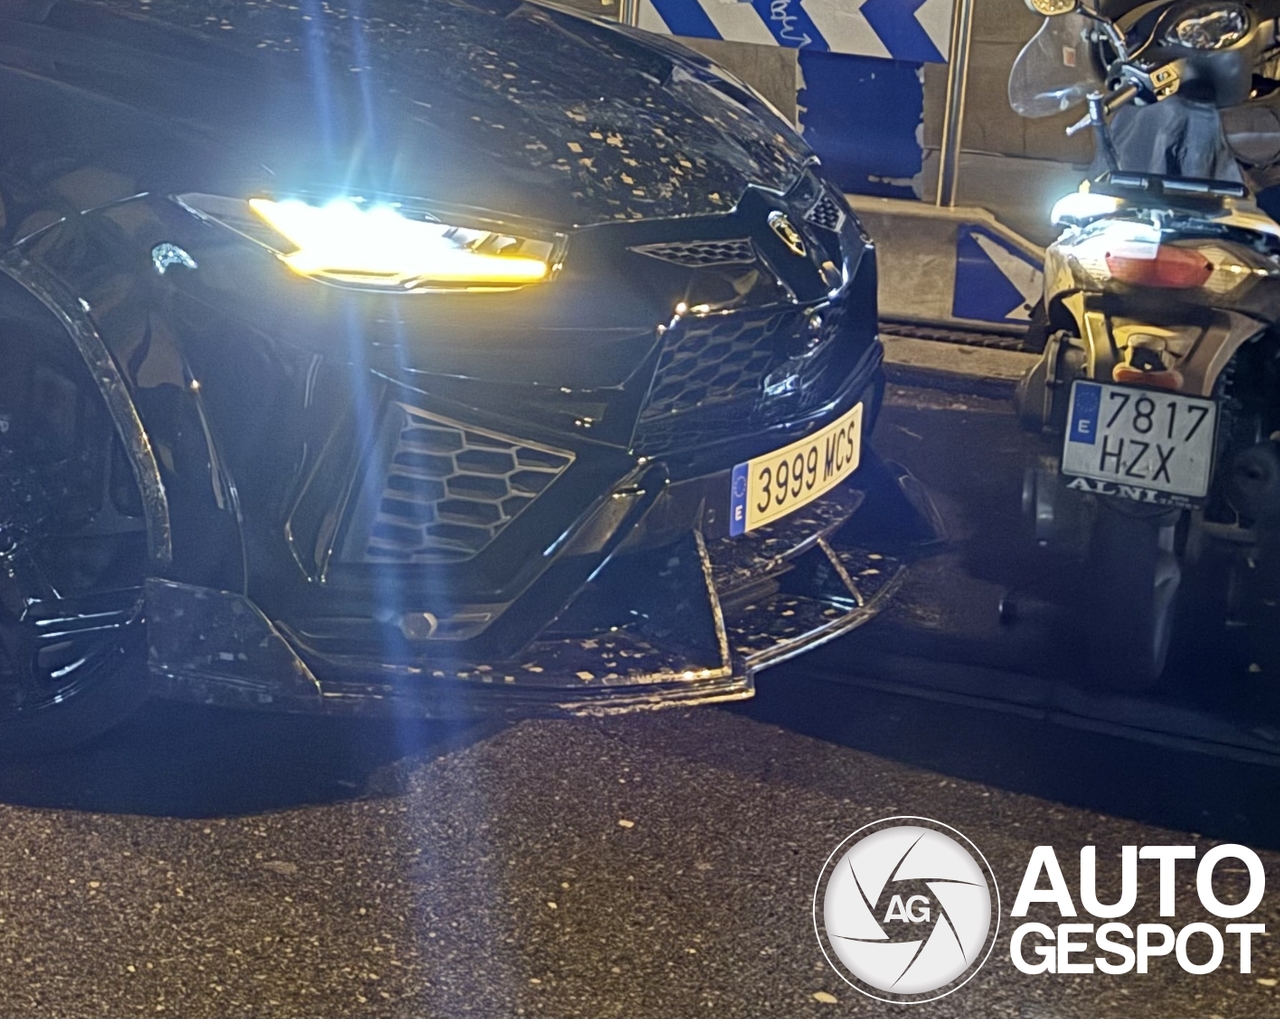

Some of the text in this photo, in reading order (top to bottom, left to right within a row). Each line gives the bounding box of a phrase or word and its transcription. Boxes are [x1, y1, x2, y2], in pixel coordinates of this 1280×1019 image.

[1077, 419, 1091, 433] E
[1106, 391, 1209, 442] 7817
[757, 420, 855, 513] 3999 MCS
[1099, 434, 1175, 484] HZX
[1066, 477, 1158, 503] ALNI
[734, 505, 743, 521] E
